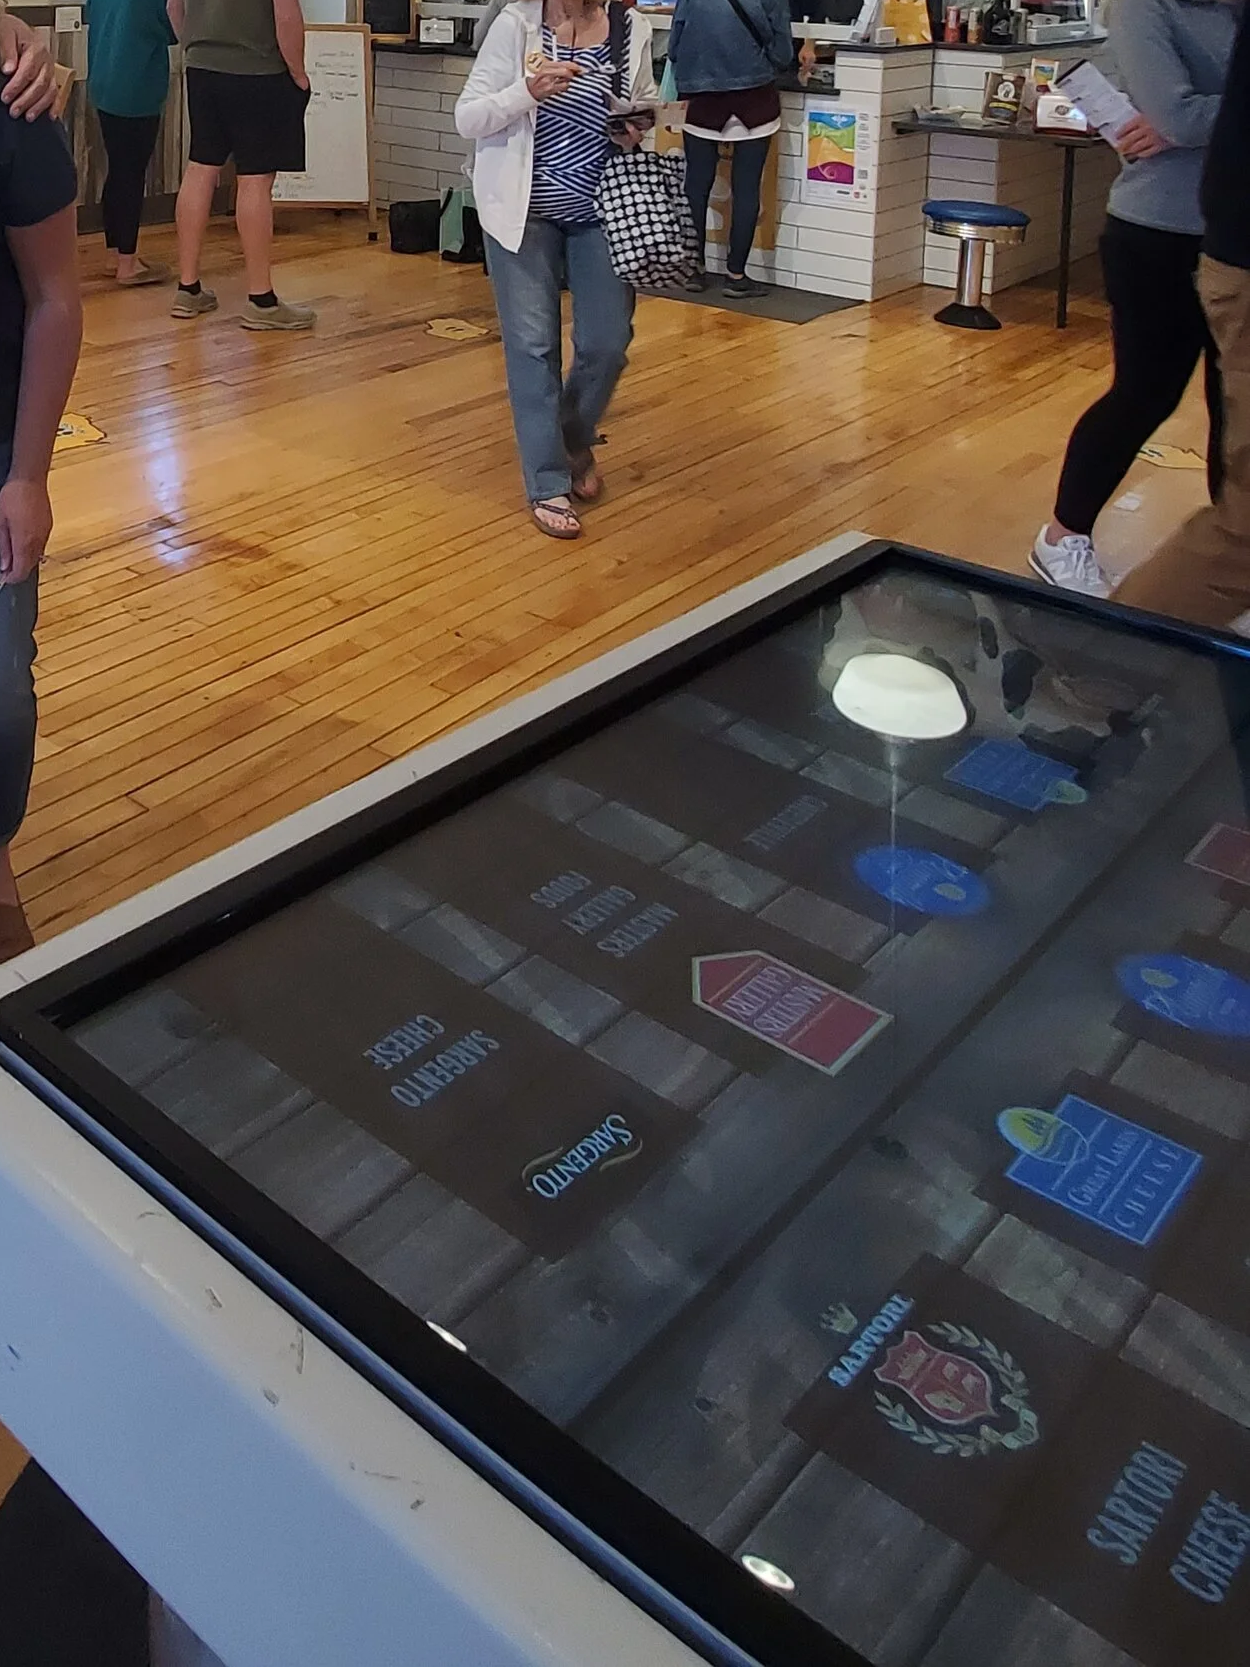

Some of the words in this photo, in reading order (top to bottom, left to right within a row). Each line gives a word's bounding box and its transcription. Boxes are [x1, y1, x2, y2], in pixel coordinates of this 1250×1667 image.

[362, 1014, 445, 1070] CHEESE
[390, 1029, 500, 1107] SARGENTO
[531, 1114, 633, 1199] SARGENTO
[1113, 1145, 1182, 1228] CHEESE
[828, 1293, 915, 1387] SARTORI
[1086, 1440, 1188, 1565] SARTORI
[1169, 1489, 1250, 1603] CHEESE
